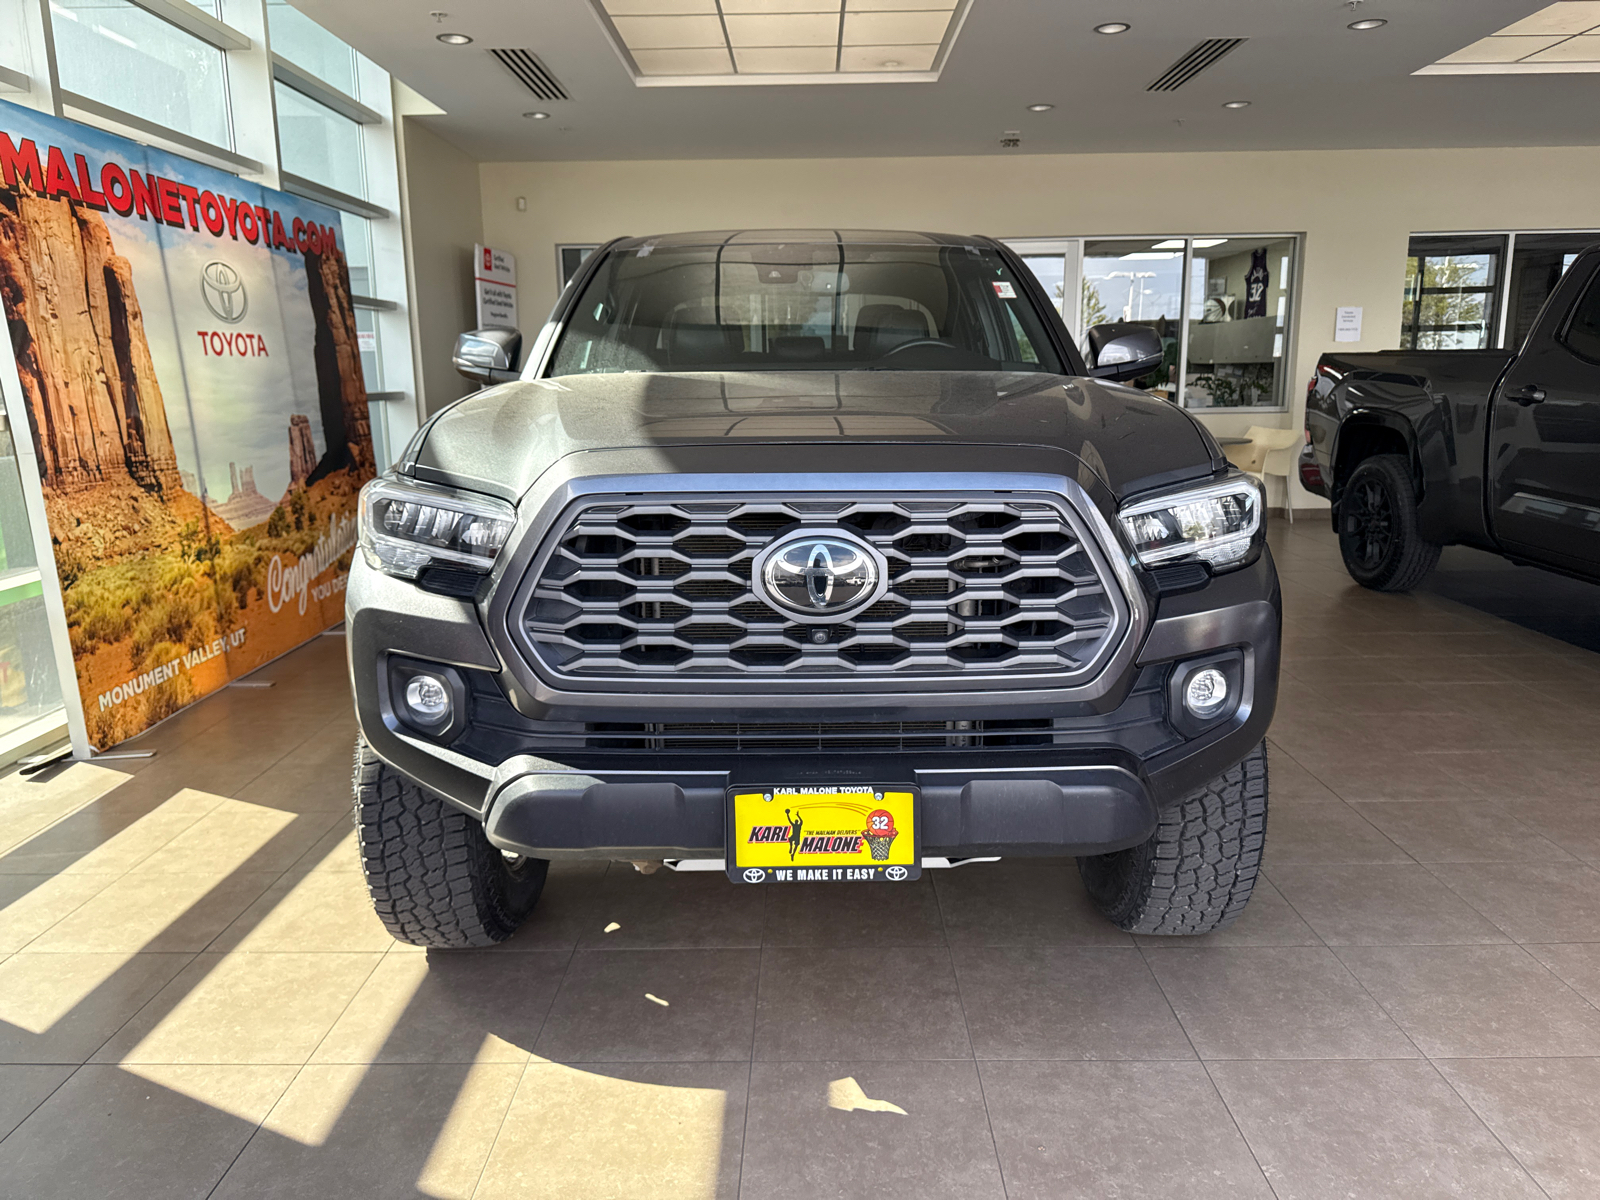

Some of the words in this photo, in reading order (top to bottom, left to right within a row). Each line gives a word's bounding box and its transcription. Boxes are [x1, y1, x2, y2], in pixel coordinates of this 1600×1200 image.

[0, 130, 338, 256] MALONETOYOTA.COM
[1249, 283, 1264, 302] 32
[197, 331, 269, 358] TOYOTA
[311, 581, 331, 602] YOU
[98, 658, 180, 712] MONUMENT
[182, 638, 230, 670] VALLEY,
[229, 628, 247, 647] UT
[773, 787, 798, 795] KARL
[800, 787, 838, 795] MALONE
[839, 786, 874, 794] TOYOTA
[871, 816, 889, 830] 32
[748, 826, 791, 843] KARL
[799, 835, 863, 854] MALONE
[775, 869, 794, 881] WE
[797, 869, 829, 881] MAKE
[832, 868, 843, 880] IT
[846, 868, 875, 880] EASY
